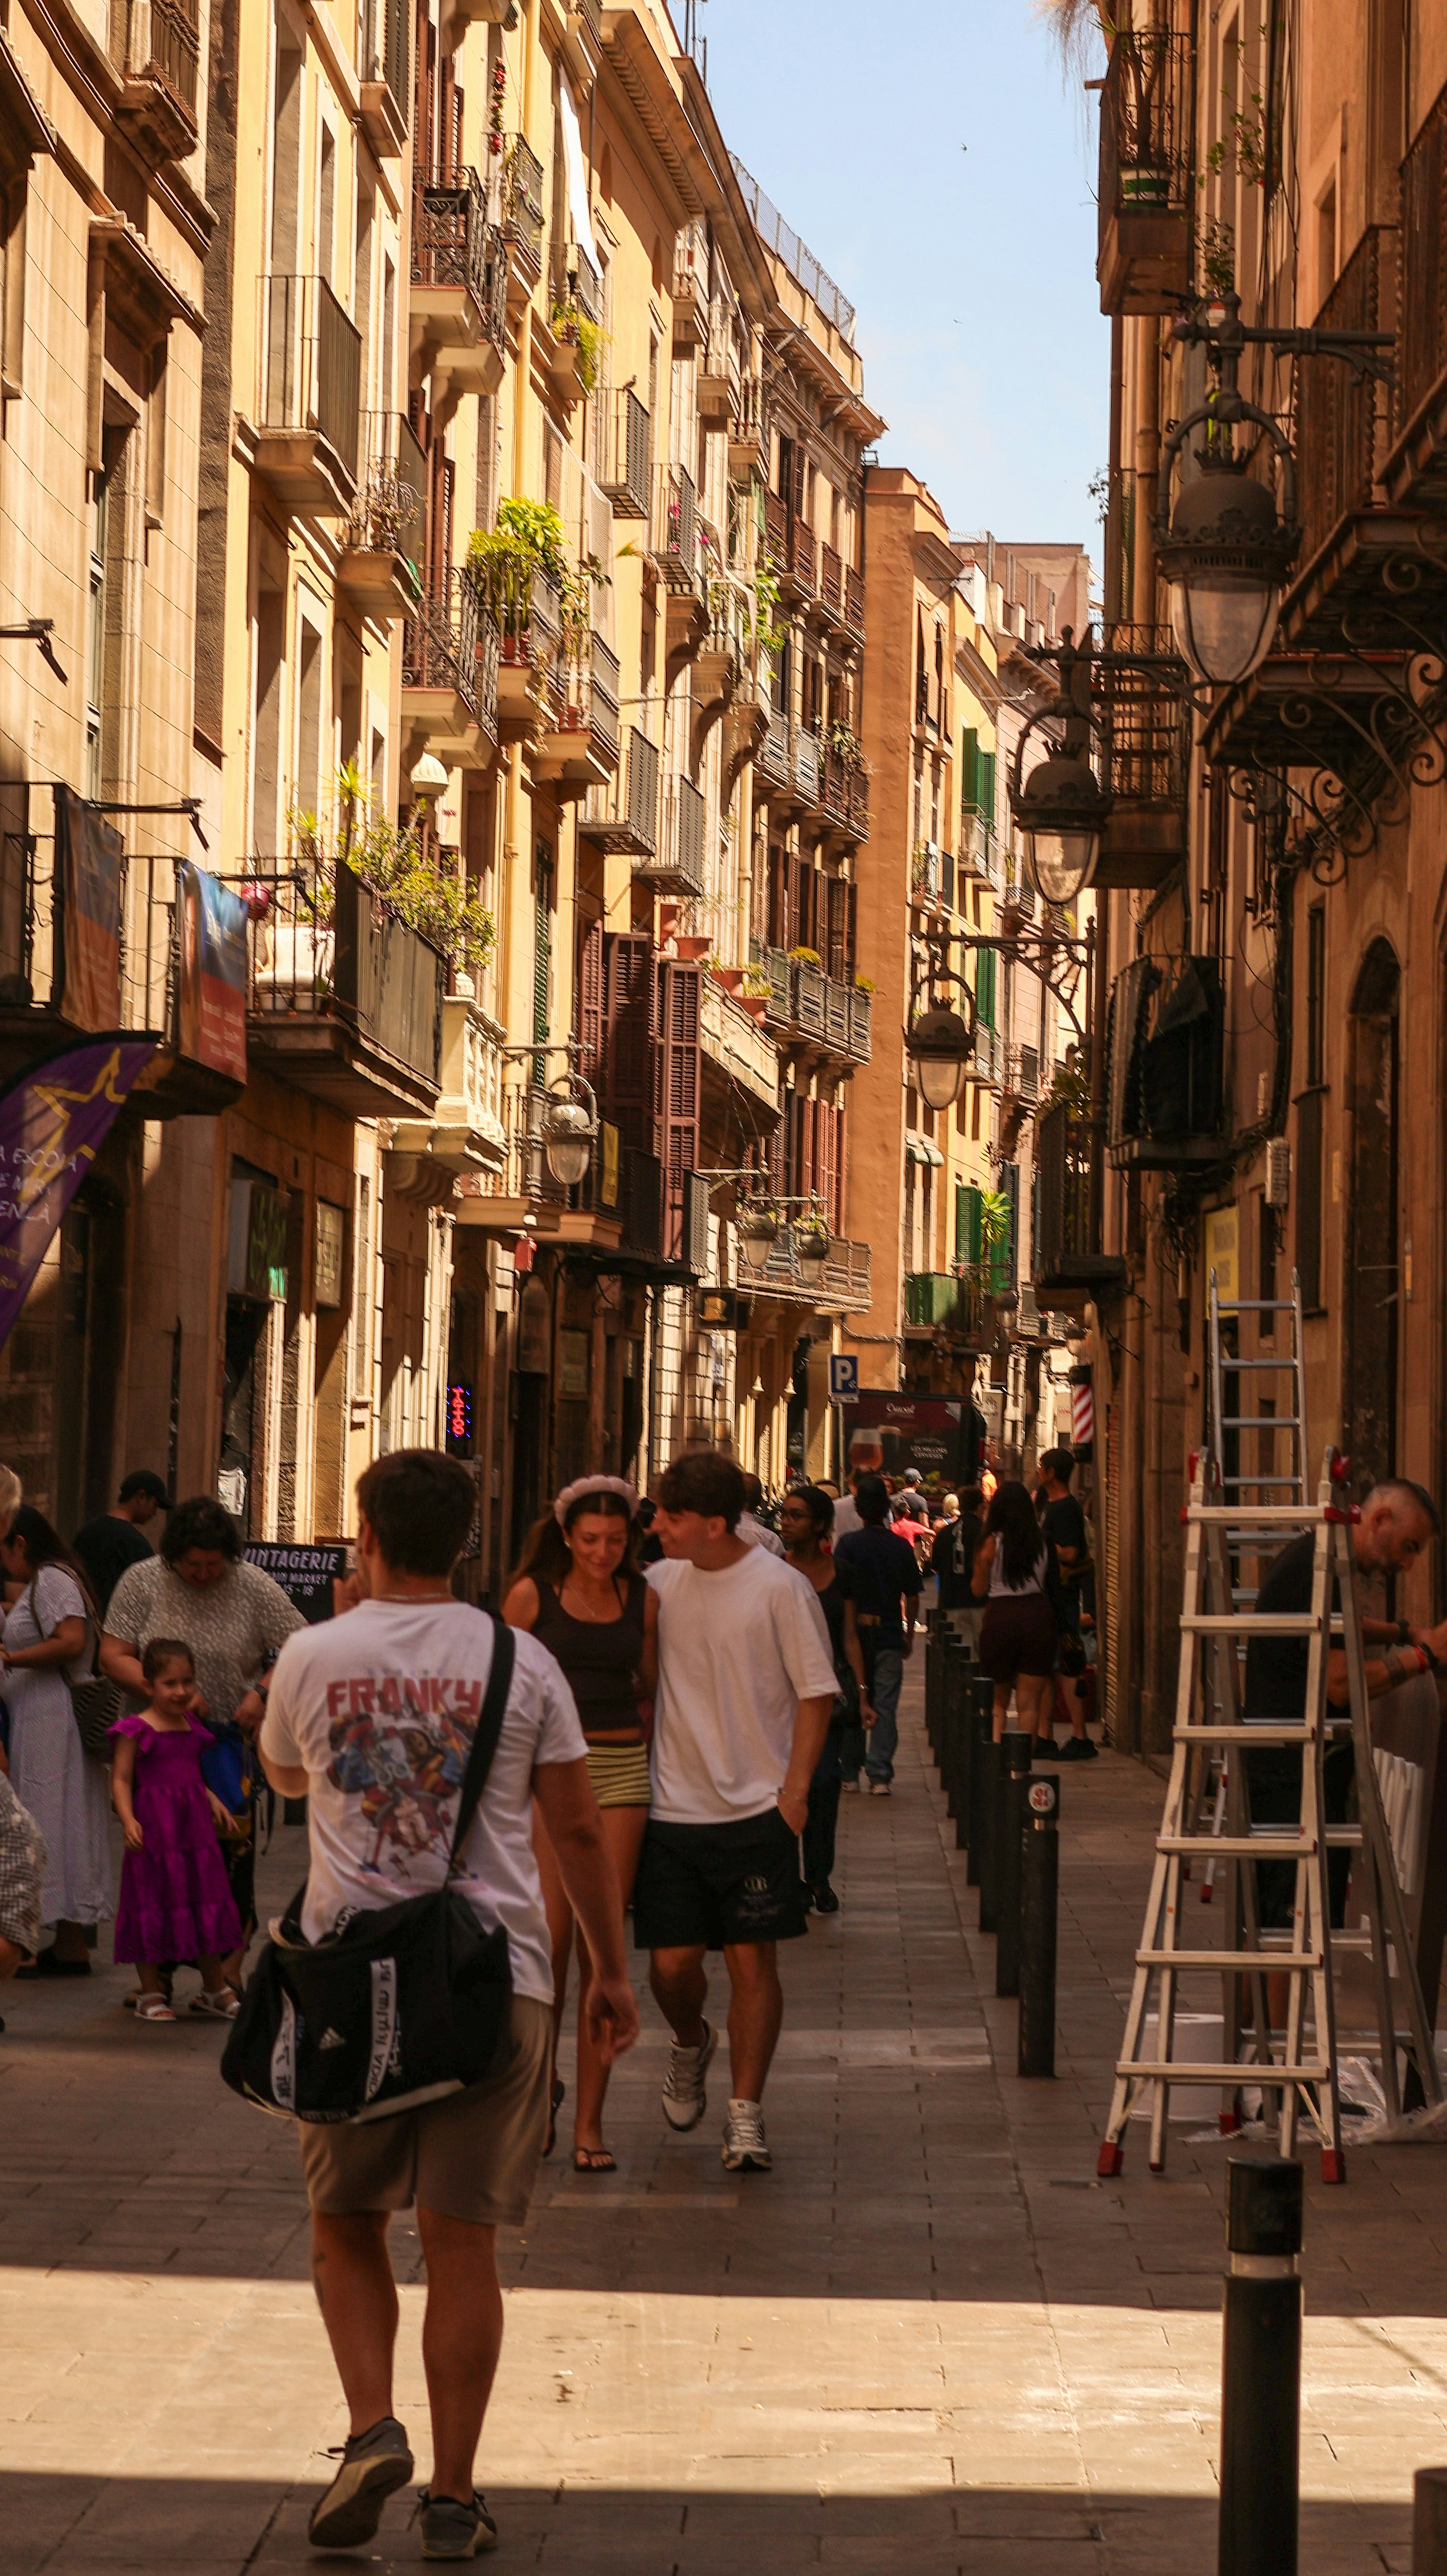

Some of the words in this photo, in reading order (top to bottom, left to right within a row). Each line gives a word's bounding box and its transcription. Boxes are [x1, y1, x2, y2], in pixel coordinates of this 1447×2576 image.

[835, 1358, 853, 1390] P
[242, 1548, 339, 1571] VINTAGERIE
[327, 1677, 481, 1717] FRANKY
